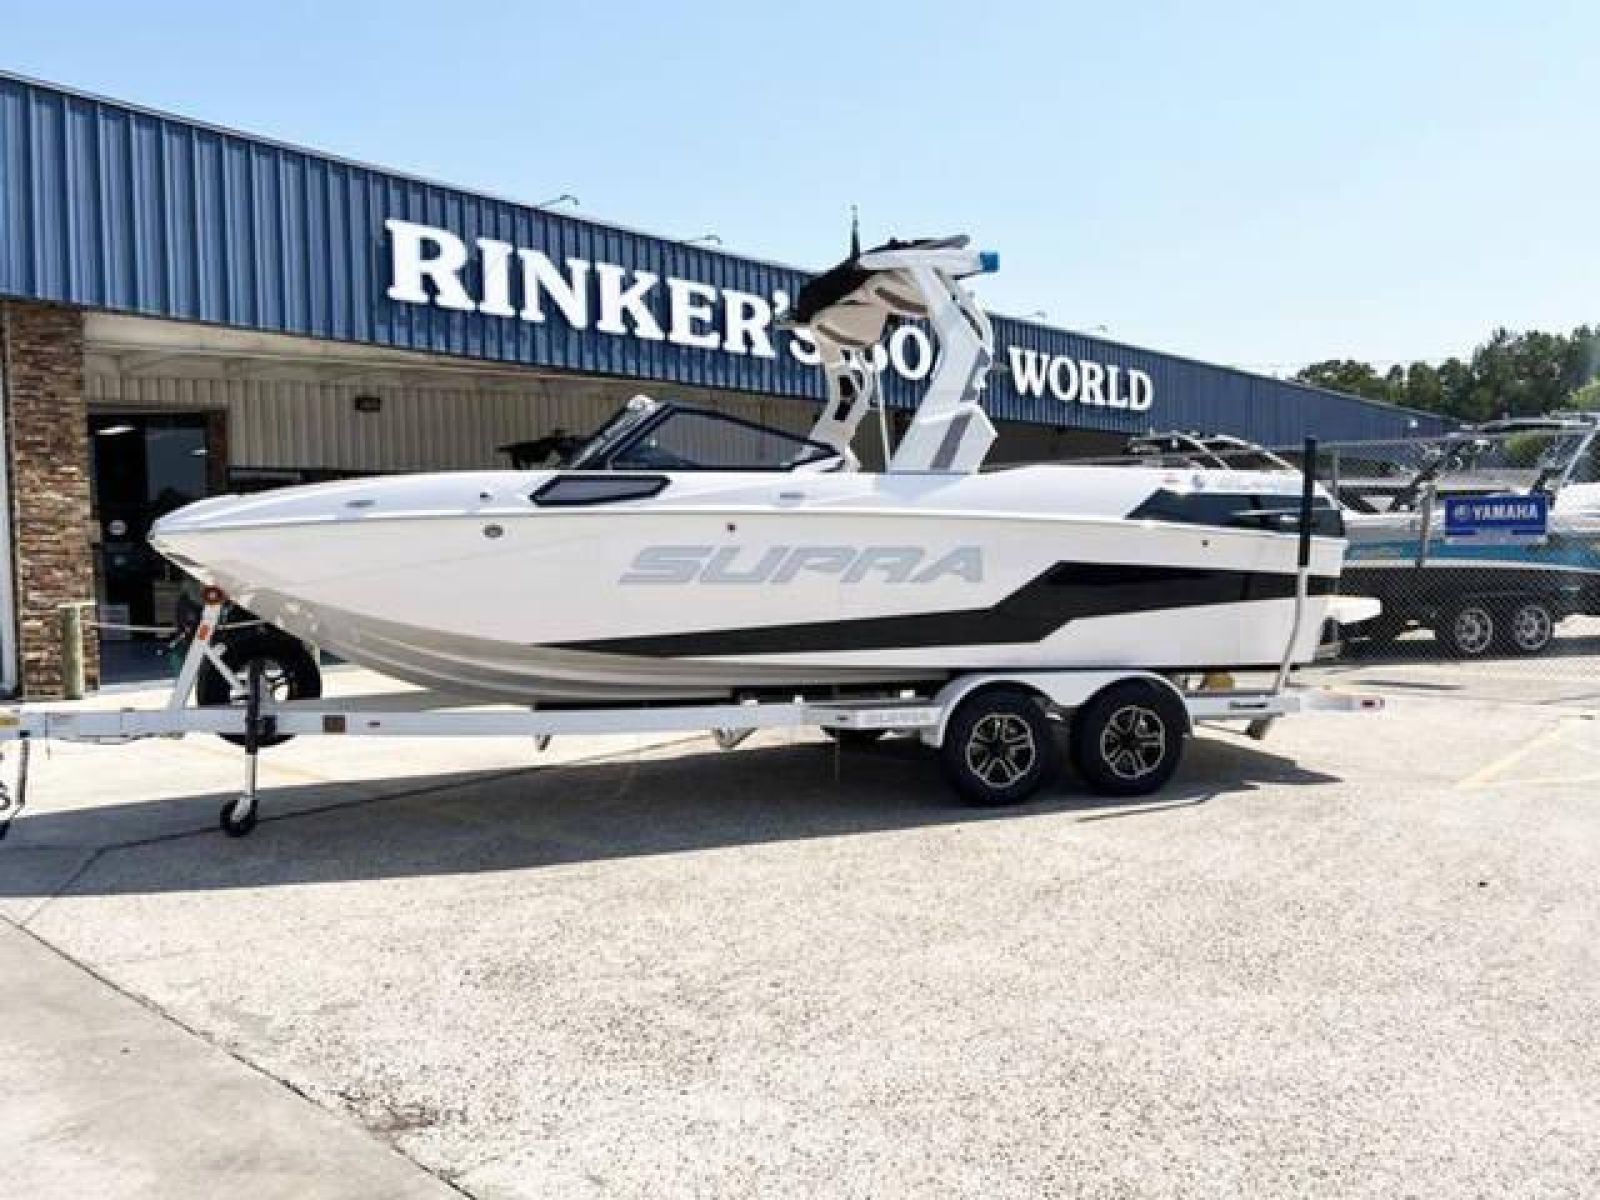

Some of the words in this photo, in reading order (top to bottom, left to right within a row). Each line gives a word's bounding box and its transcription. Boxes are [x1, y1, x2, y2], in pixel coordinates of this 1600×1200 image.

[385, 219, 822, 365] RINKER'S
[1009, 346, 1153, 411] WORLD
[1473, 503, 1539, 520] YAMAHA
[616, 544, 984, 585] SUPRA
